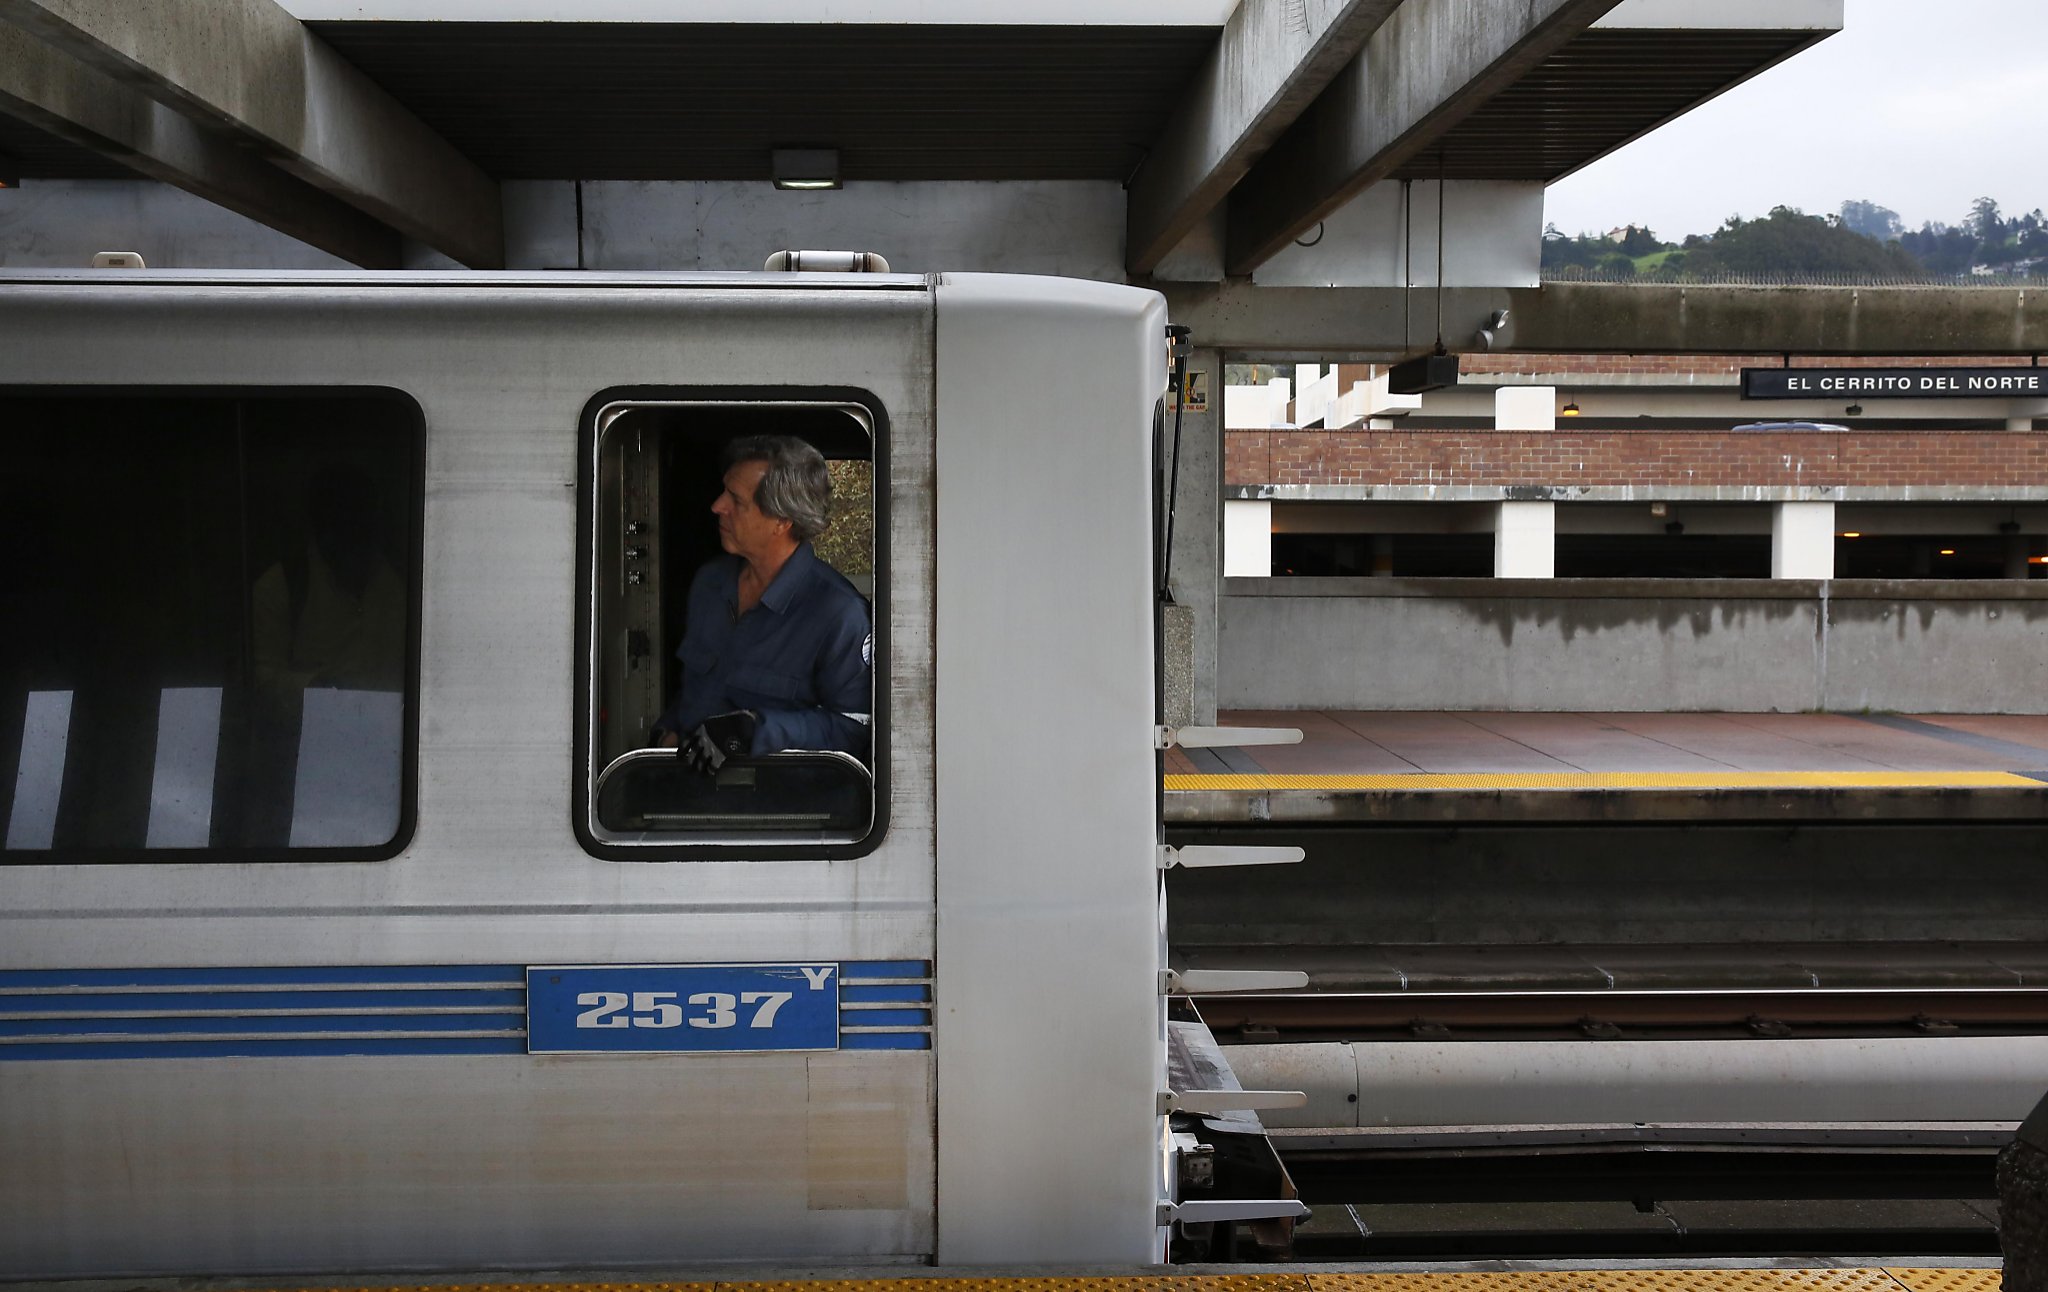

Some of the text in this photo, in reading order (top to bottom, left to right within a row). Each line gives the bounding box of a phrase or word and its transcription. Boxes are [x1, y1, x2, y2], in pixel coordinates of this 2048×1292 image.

[1787, 376, 2039, 390] EL CERRITO DEL NORTE
[800, 968, 833, 990] Y
[576, 992, 793, 1028] 2537
